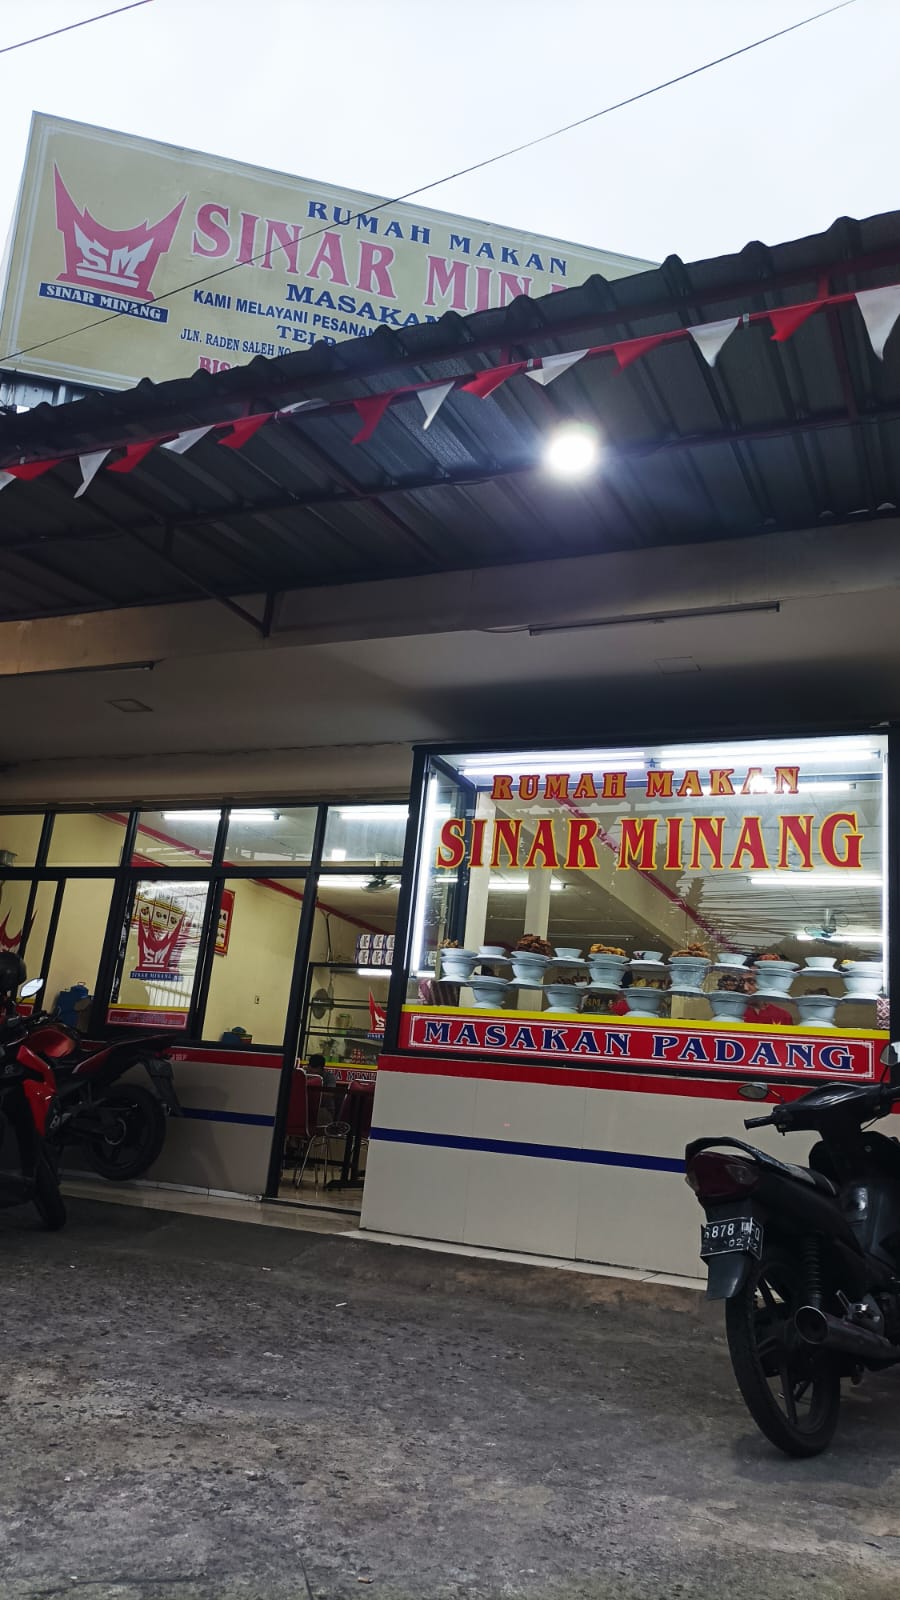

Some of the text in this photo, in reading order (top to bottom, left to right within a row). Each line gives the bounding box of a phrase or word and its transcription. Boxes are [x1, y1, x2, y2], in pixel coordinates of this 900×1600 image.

[193, 203, 567, 312] SINAR MIN
[307, 201, 567, 276] RUMAH MAKAN
[46, 285, 161, 320] SINAR MINANG
[193, 289, 231, 309] KAMI
[236, 298, 308, 324] MELAYANI
[180, 328, 202, 343] JLN.
[205, 332, 240, 351] RADEN
[242, 340, 275, 356] SALEH
[491, 766, 800, 800] RUMAH MAKAN
[436, 812, 864, 870] SINAR MINANG
[424, 1021, 854, 1071] MASAKAN PADANG
